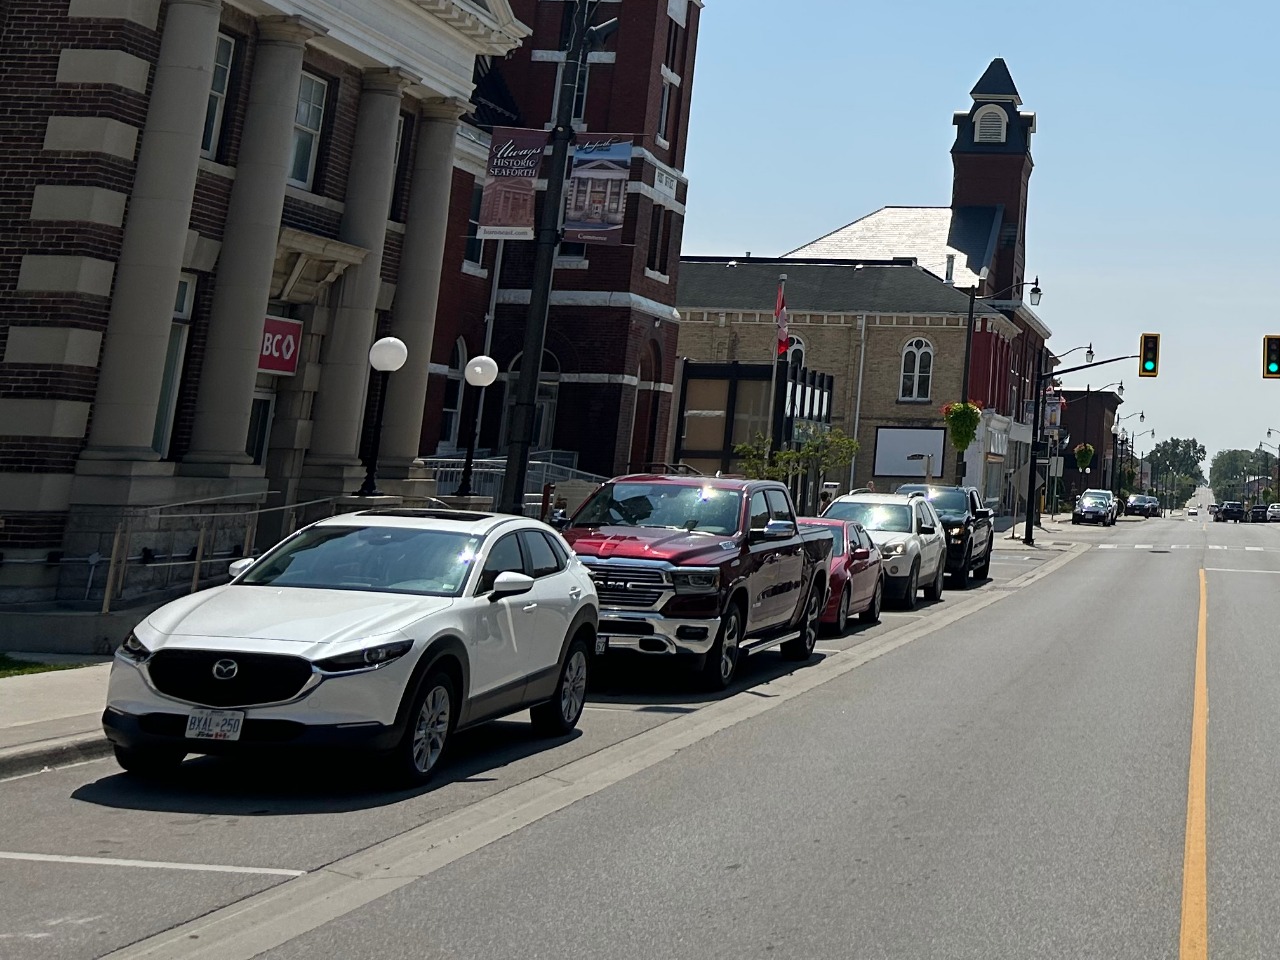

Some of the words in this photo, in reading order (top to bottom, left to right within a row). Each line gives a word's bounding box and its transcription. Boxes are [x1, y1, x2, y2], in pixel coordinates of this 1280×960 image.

[492, 139, 542, 161] Always
[493, 159, 536, 168] HISTORIC
[489, 168, 536, 177] SEAFORTH
[262, 332, 282, 357] BC
[188, 716, 213, 732] BXAL
[220, 717, 241, 733] 250
